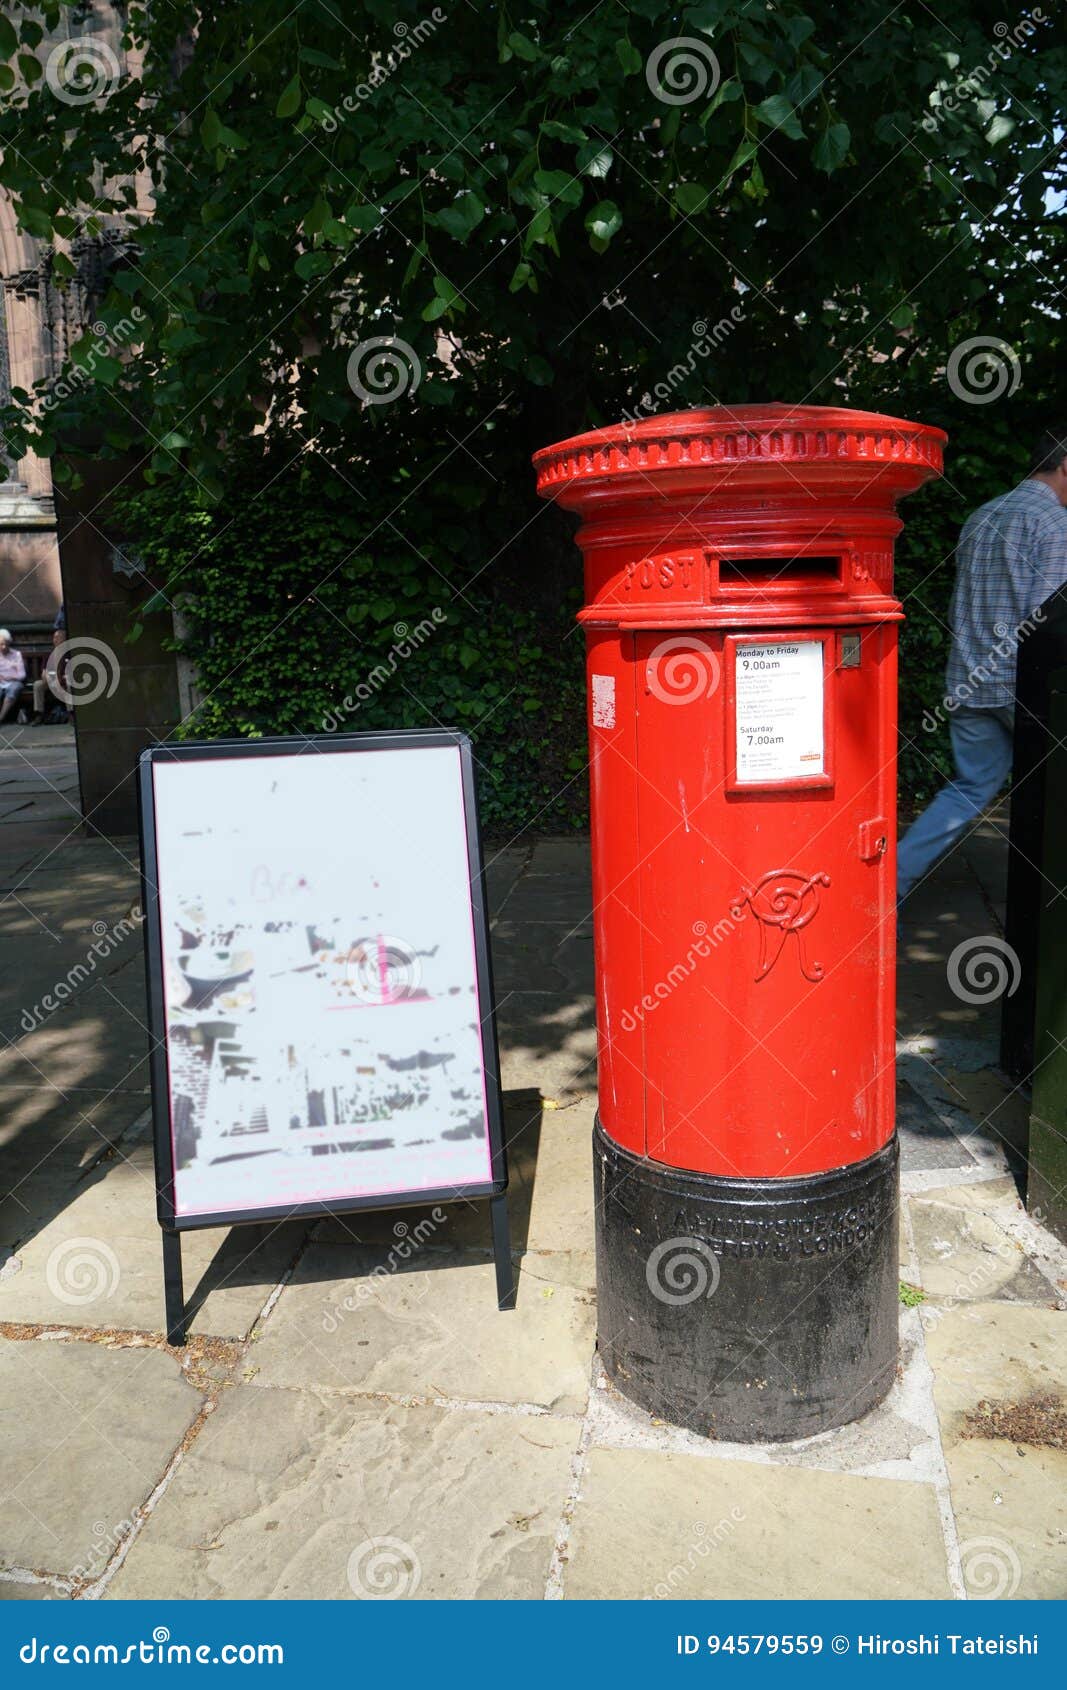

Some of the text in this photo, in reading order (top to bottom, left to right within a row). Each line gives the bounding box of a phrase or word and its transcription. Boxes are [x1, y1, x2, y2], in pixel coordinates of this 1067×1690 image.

[625, 556, 694, 591] POST
[736, 646, 799, 658] Monday to Friday
[742, 660, 780, 671] 9.00am
[740, 724, 773, 734] Saturday
[747, 735, 784, 746] 7.00am
